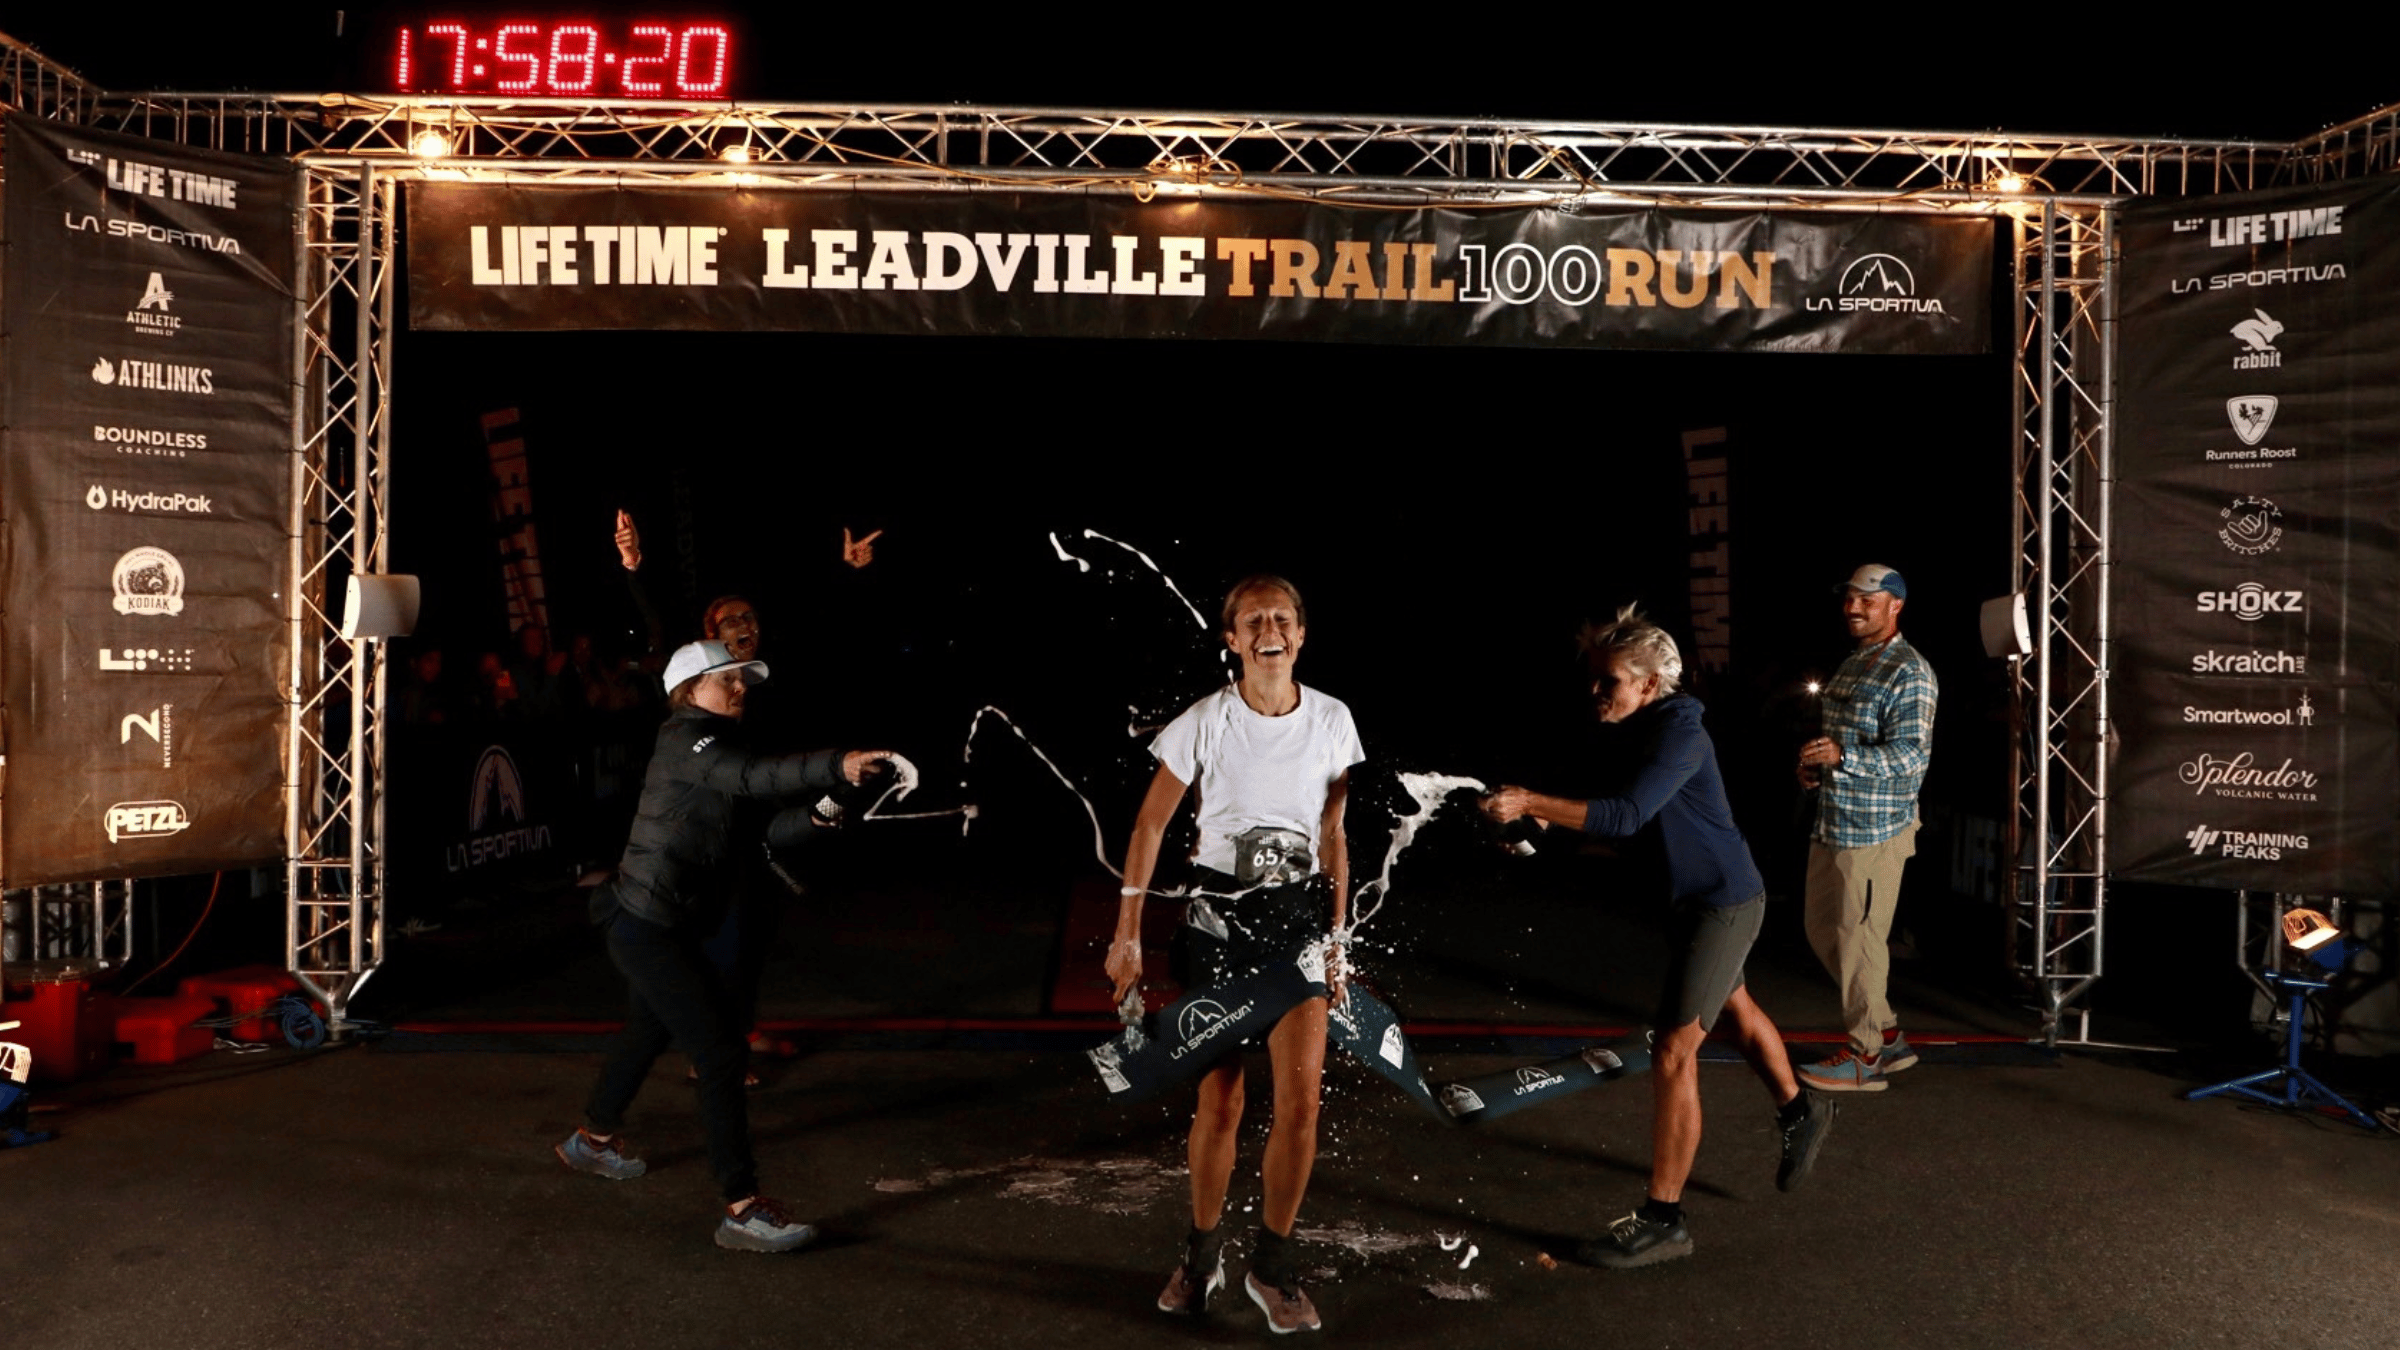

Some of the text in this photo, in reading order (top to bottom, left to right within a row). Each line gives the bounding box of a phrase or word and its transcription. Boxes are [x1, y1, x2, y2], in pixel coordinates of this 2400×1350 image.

[107, 158, 237, 209] LIFE TIME
[65, 212, 241, 254] LA SPORTIVA
[2210, 206, 2344, 248] LIFE TIME
[471, 226, 1776, 309] LIFE TIME LEADVILLE TRAIL 100 RUN
[2172, 264, 2346, 293] LA SPORTIVA
[1806, 298, 1943, 313] LA SPORTIVA
[127, 311, 181, 328] ATHLETIC
[2233, 351, 2281, 369] rabbit
[119, 360, 213, 394] ATHLINKS
[94, 426, 207, 449] BOUNDLESS
[116, 446, 186, 458] COACHING
[2206, 447, 2297, 461] Runners Roost
[2229, 462, 2273, 470] COLORADO
[1681, 425, 1728, 536] LIFE
[112, 490, 212, 513] HydraPak
[2220, 495, 2283, 519] SALTY
[2219, 527, 2282, 555] BRITCHES
[128, 597, 170, 611] KODIAK
[2197, 591, 2303, 612] SHOKZ
[2192, 650, 2295, 673] skratch
[2183, 706, 2291, 725] Smartwool
[2178, 752, 2318, 795] Splendor
[2215, 788, 2318, 802] VOLCANIC WATER
[109, 806, 191, 844] PETZL
[470, 824, 553, 866] SPORTIVA
[2222, 831, 2309, 849] TRAINING
[2222, 845, 2281, 860] PEAKS
[1170, 1005, 1252, 1060] LA SPORTIVA
[1525, 1075, 1565, 1092] SPORTIVA
